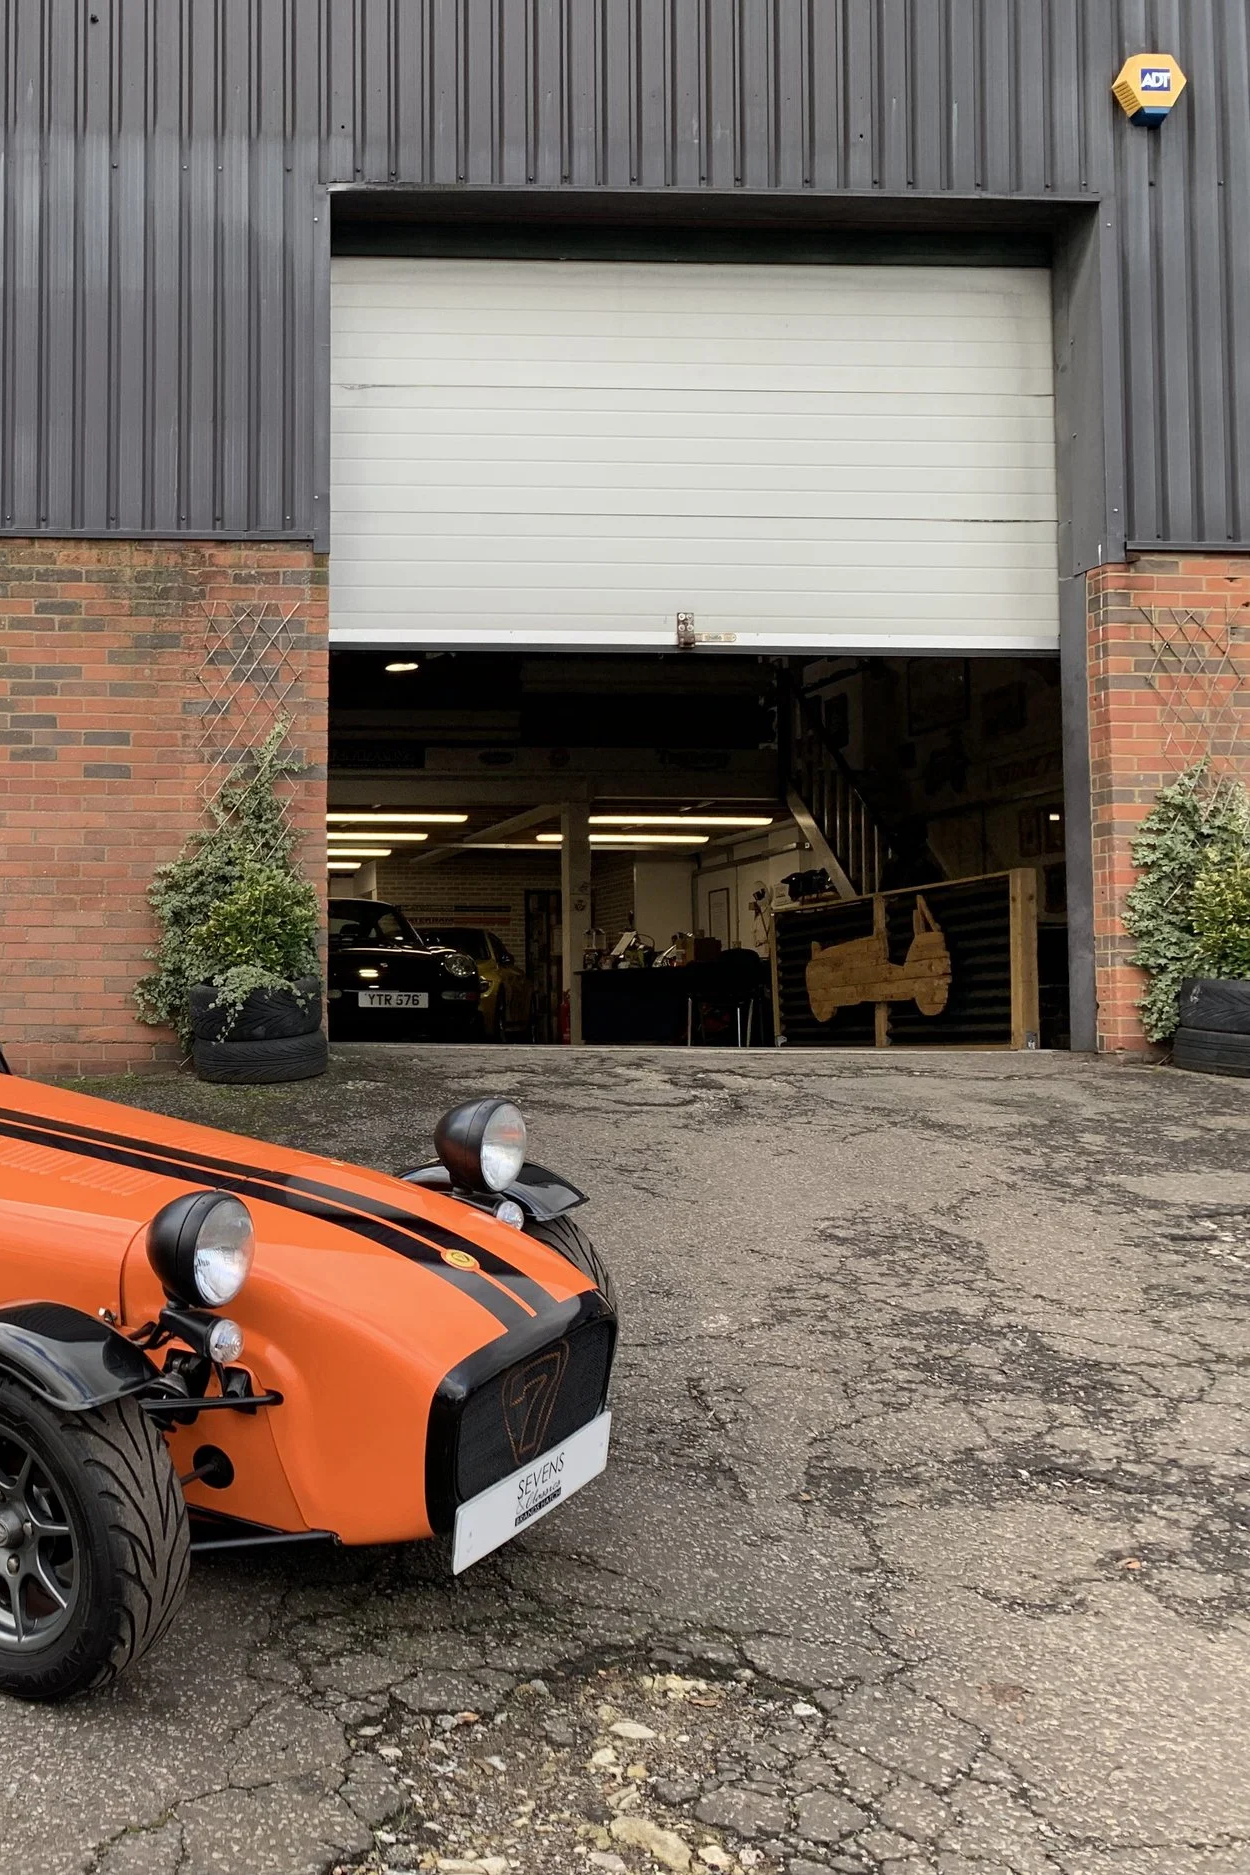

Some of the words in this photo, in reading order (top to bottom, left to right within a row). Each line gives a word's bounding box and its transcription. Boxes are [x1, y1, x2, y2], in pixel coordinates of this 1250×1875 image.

[1141, 72, 1170, 88] ADT
[368, 993, 392, 1006] YTR
[396, 994, 419, 1006] 576
[517, 1452, 565, 1500] SEVENS
